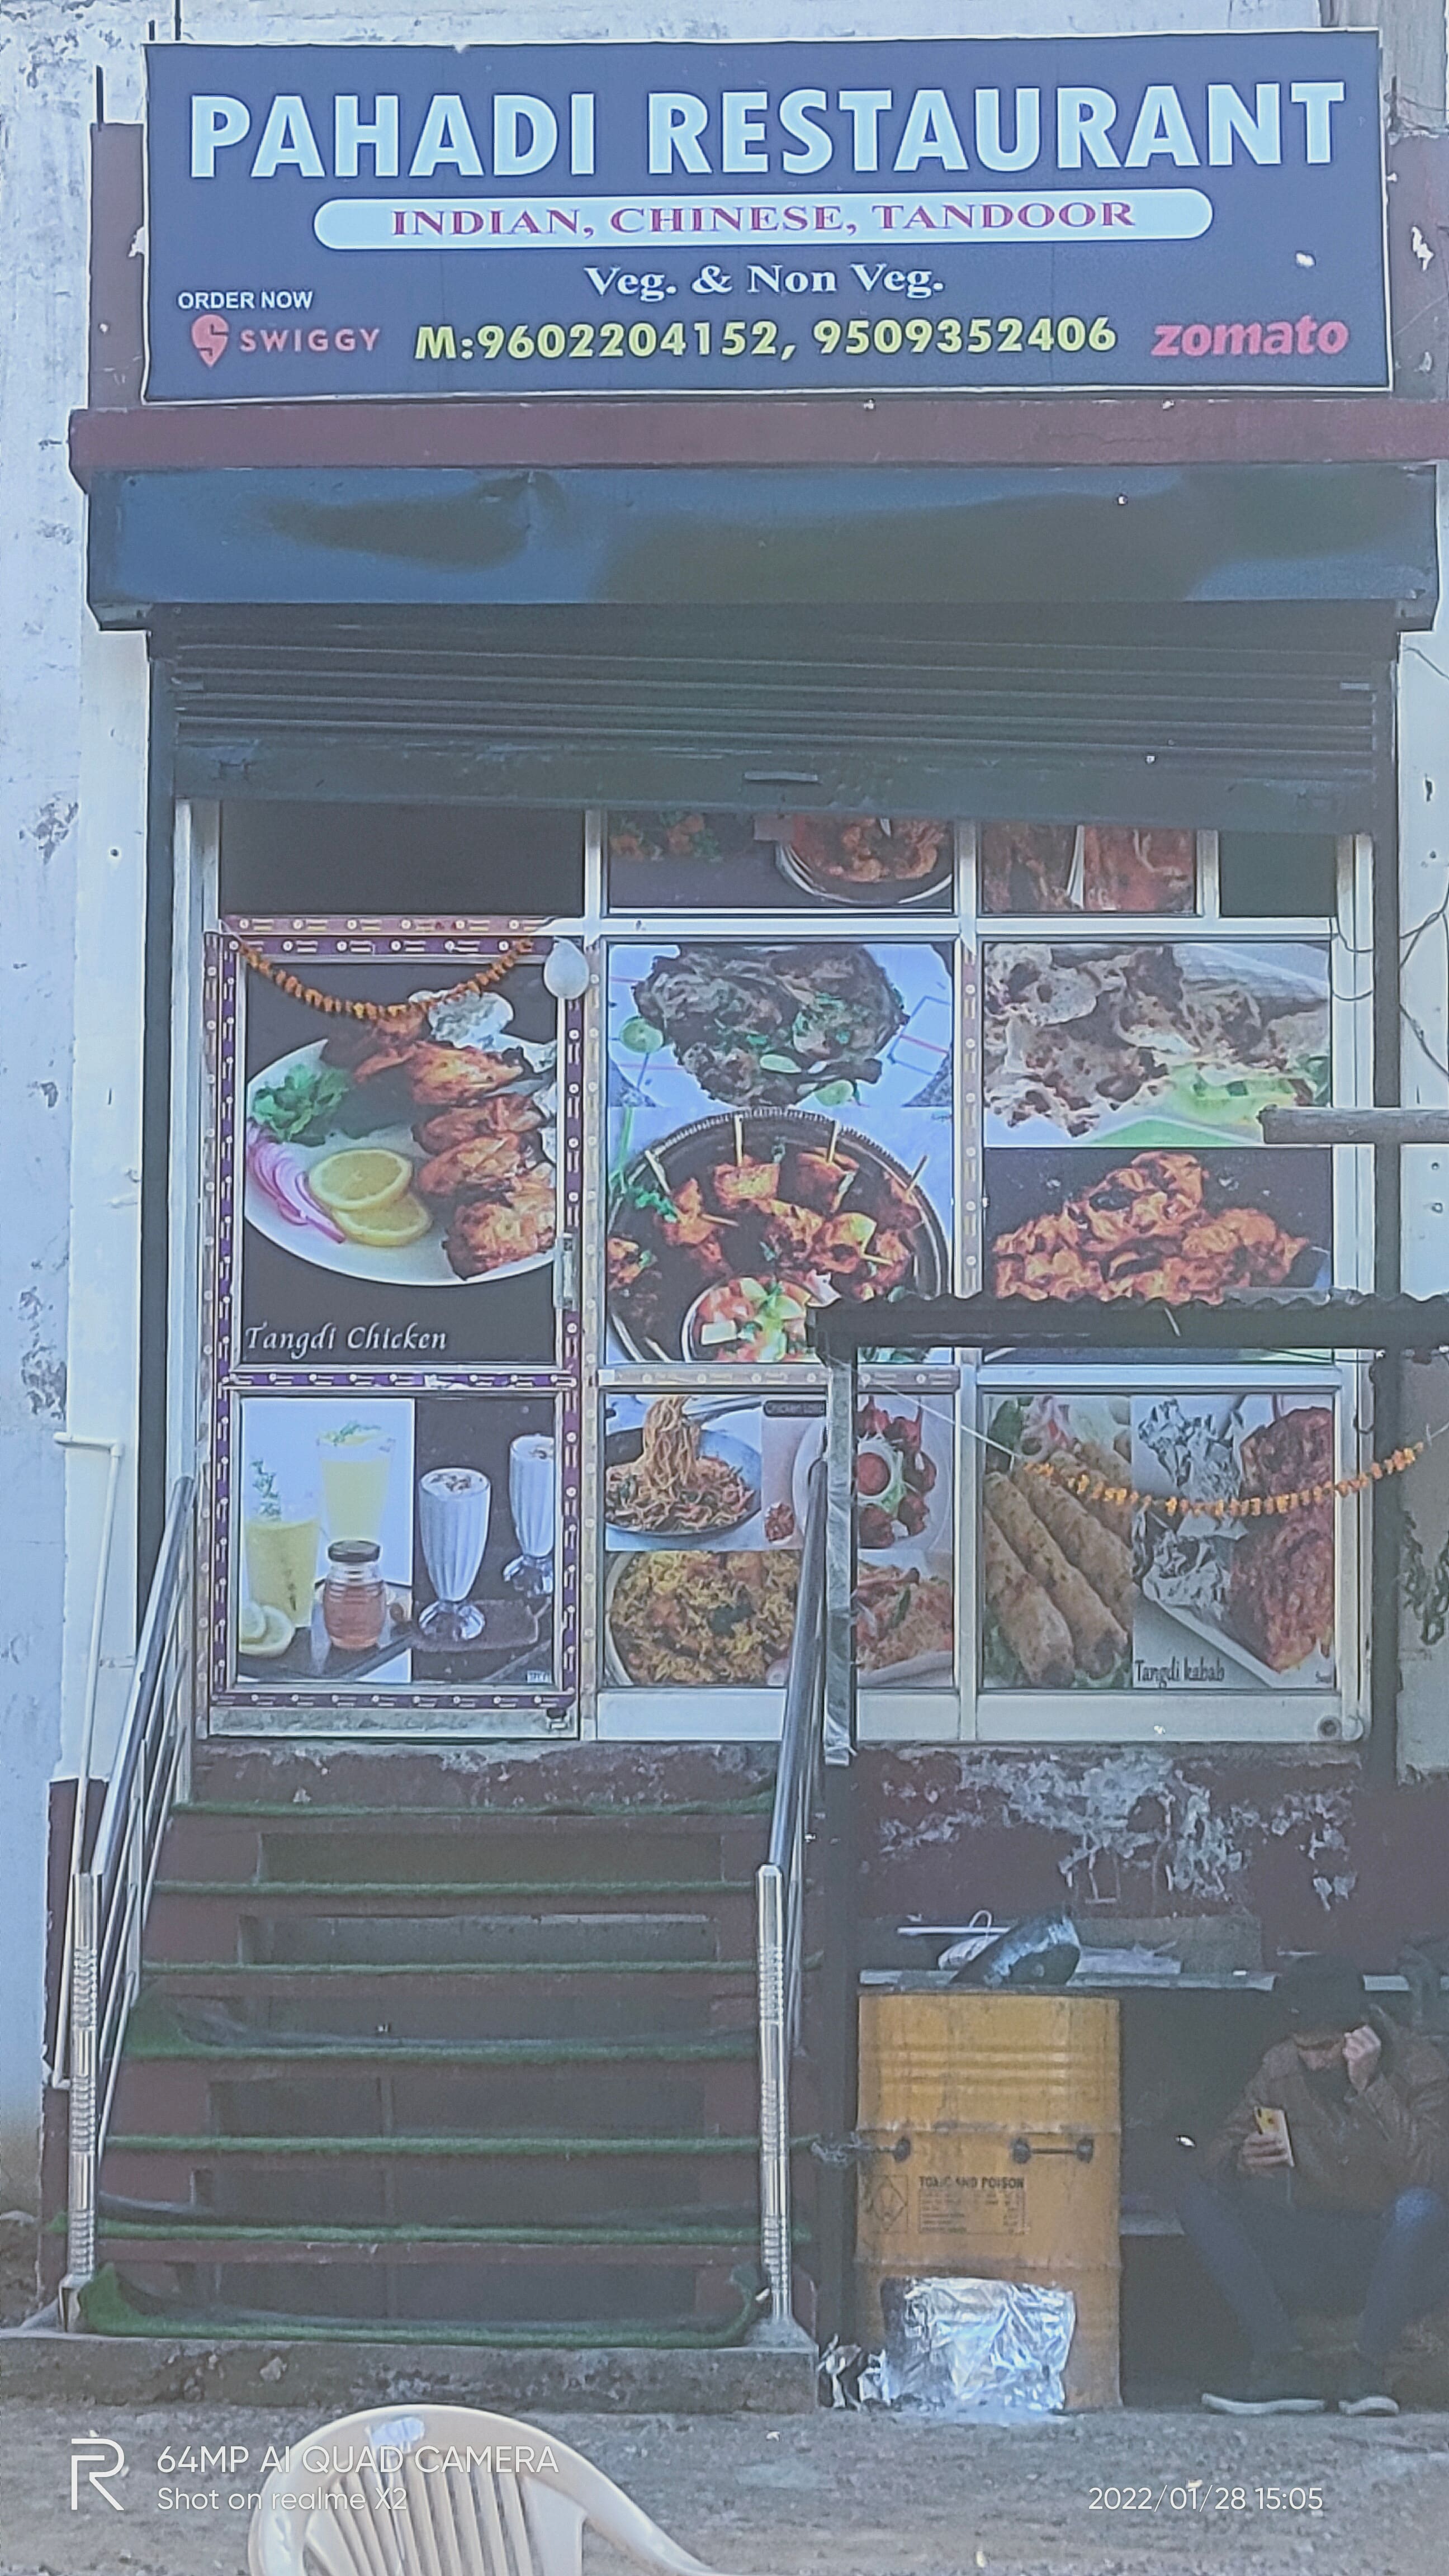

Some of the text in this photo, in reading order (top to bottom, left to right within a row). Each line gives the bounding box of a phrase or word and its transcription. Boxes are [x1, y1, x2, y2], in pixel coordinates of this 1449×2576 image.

[190, 82, 1345, 178] PAHADI RESTAURANT
[391, 201, 1137, 239] INDIAN, CHINESE, TANDOOR
[178, 290, 314, 310] ORDER NOW
[584, 263, 944, 302] Veg. & Non Veg.
[240, 328, 381, 353] SWIGGY
[414, 316, 1116, 361] M:9602204152, 9509352406
[1150, 314, 1349, 357] zomato
[245, 1320, 447, 1360] Tangdi Chicken
